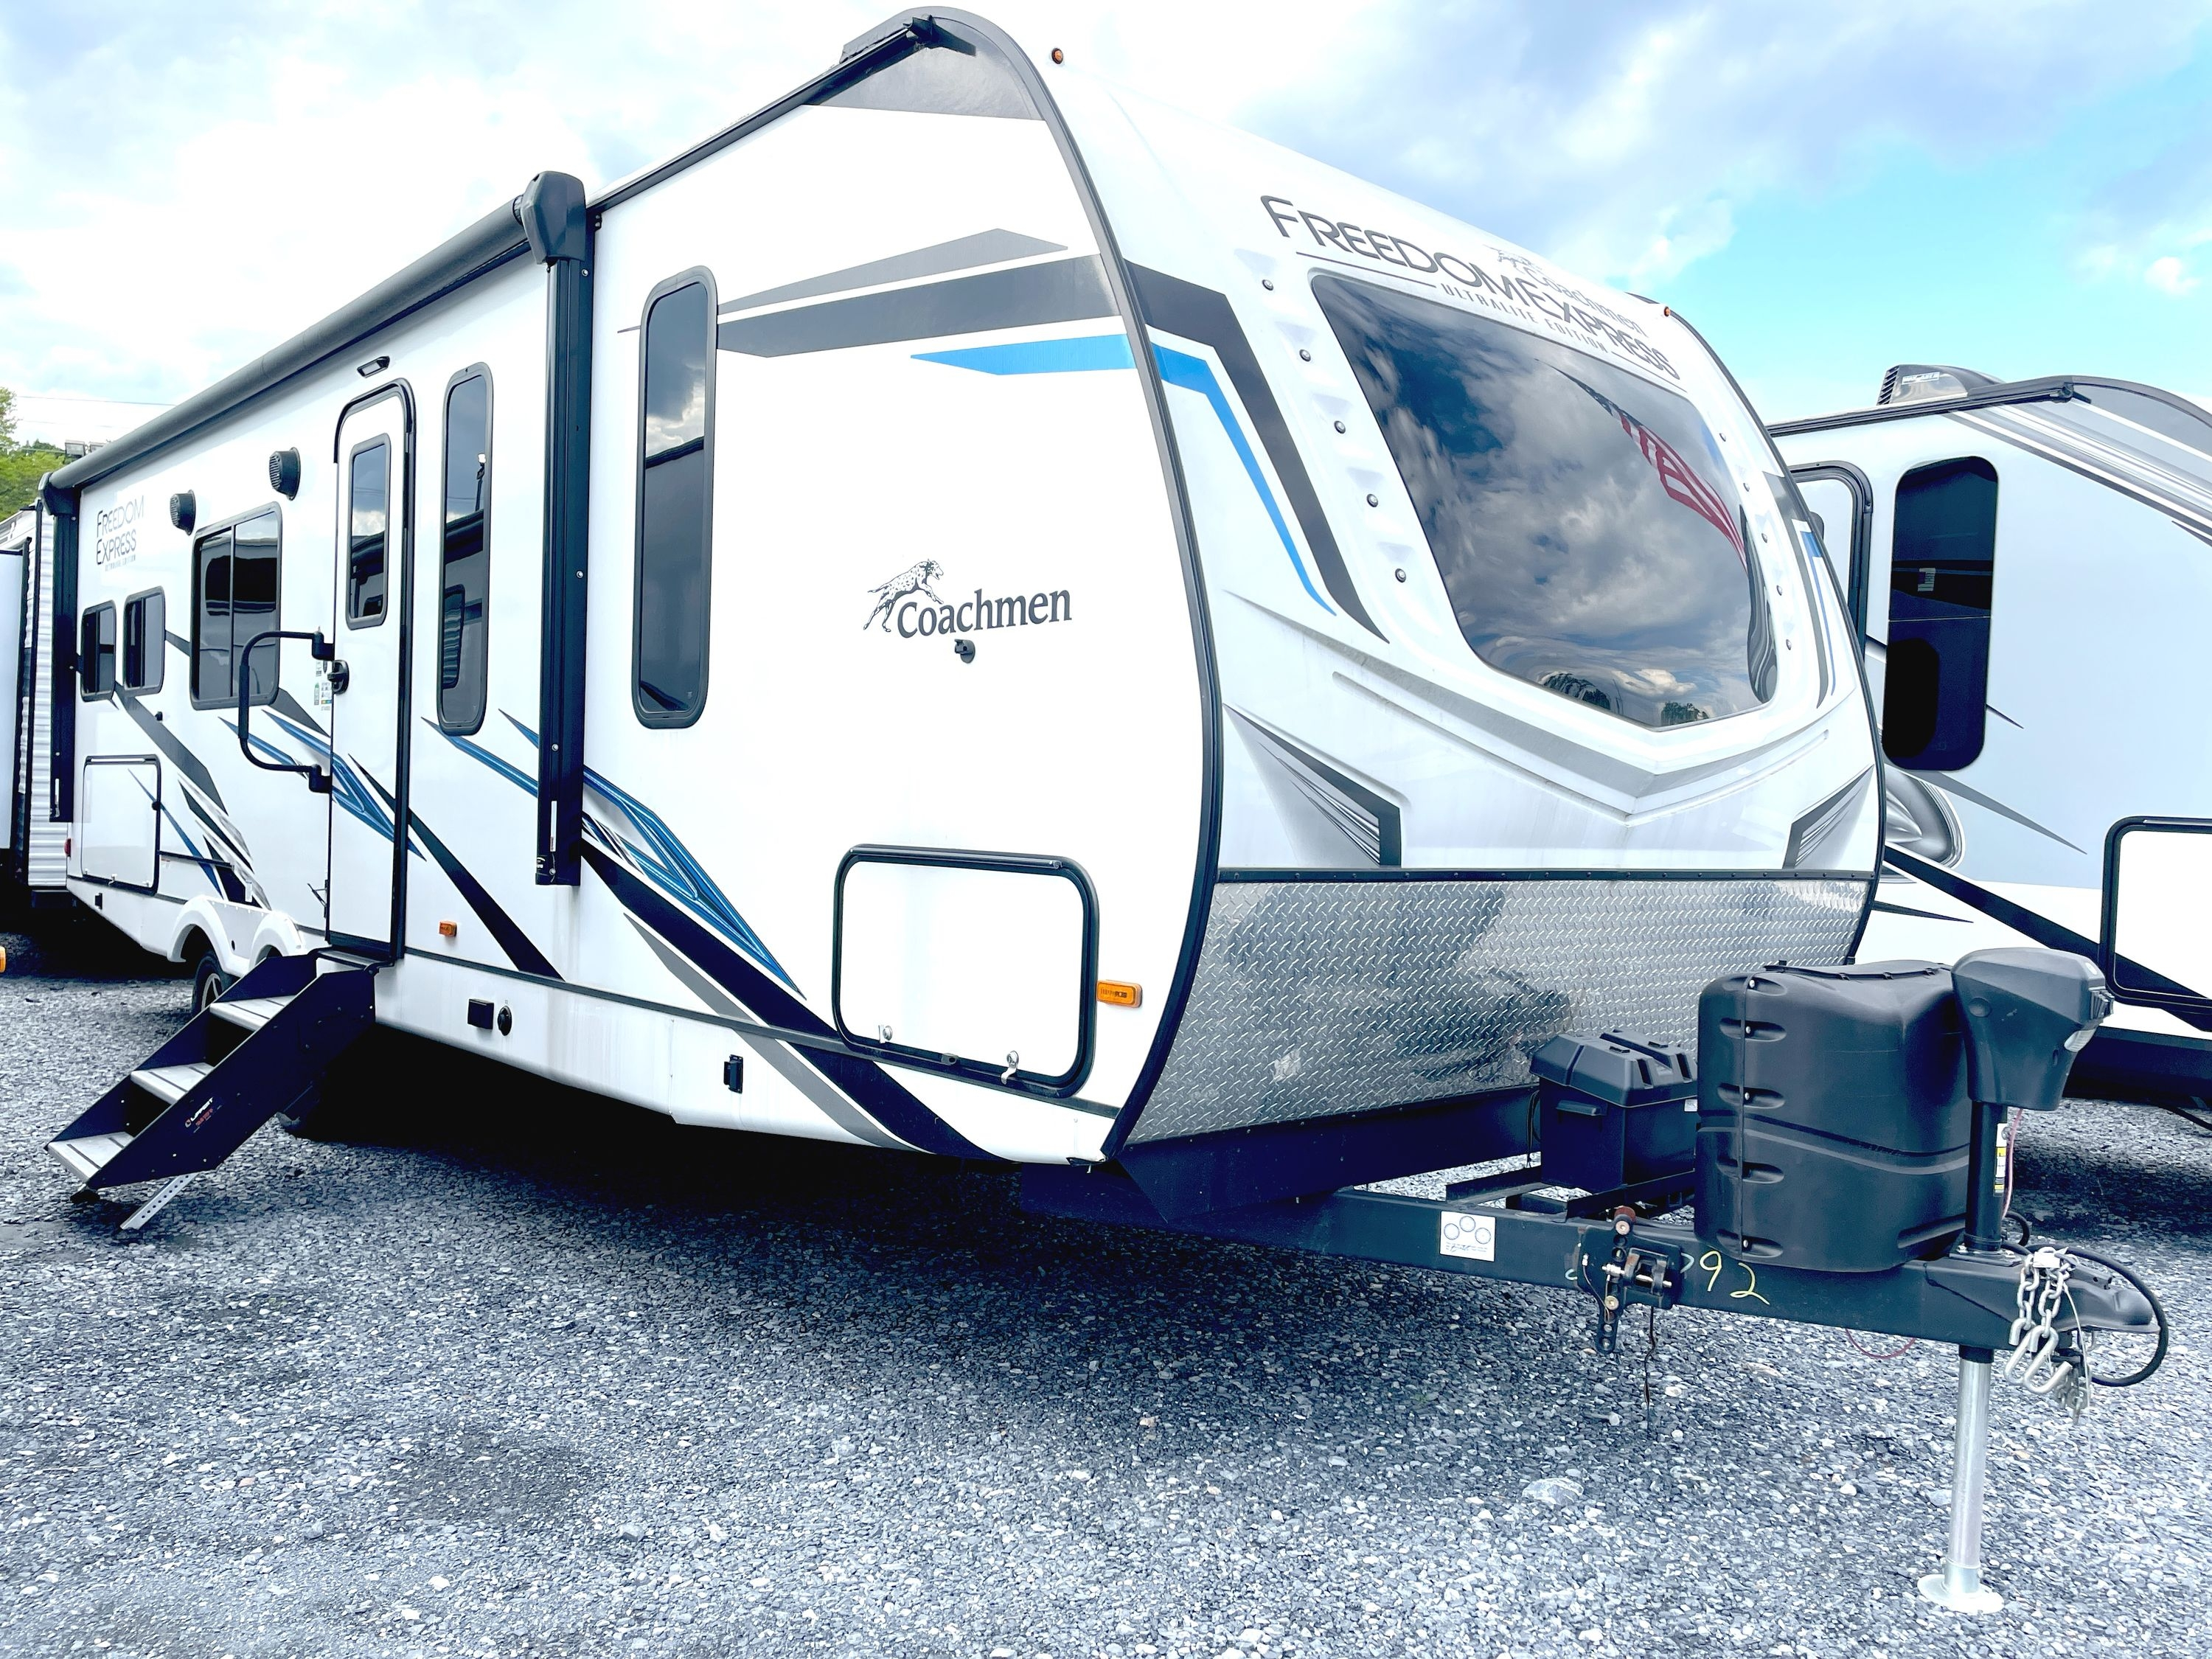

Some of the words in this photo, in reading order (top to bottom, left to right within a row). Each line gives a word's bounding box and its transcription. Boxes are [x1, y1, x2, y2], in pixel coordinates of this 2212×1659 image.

[1440, 282, 1538, 323] ULTRALITE
[1545, 317, 1609, 353] EDITION
[1523, 266, 1649, 338] Coachmen
[97, 495, 145, 538] FREEDOM
[96, 528, 137, 566] EXPRESS
[897, 588, 1073, 639] Coachmen
